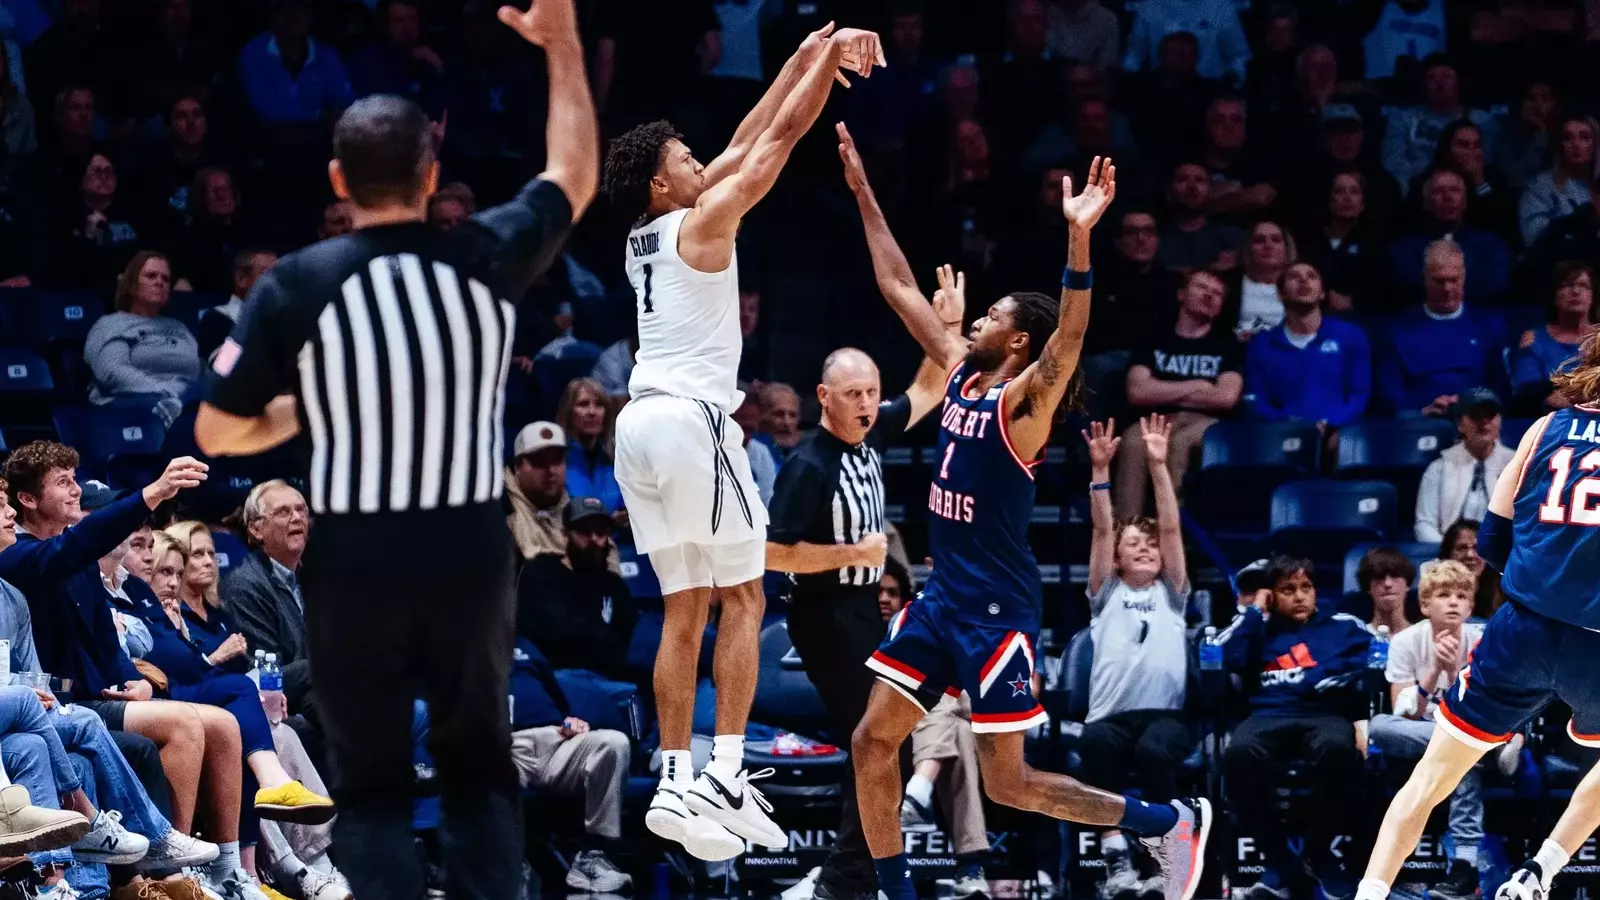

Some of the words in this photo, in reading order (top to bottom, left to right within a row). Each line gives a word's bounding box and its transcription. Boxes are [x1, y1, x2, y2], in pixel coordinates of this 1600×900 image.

[629, 231, 660, 257] CLAUDE
[643, 263, 655, 313] 1
[1568, 419, 1600, 442] LA
[940, 441, 956, 480] 1
[928, 481, 975, 523] ORRIS
[1539, 446, 1600, 526] 12
[744, 857, 798, 865] INNOVATIVE
